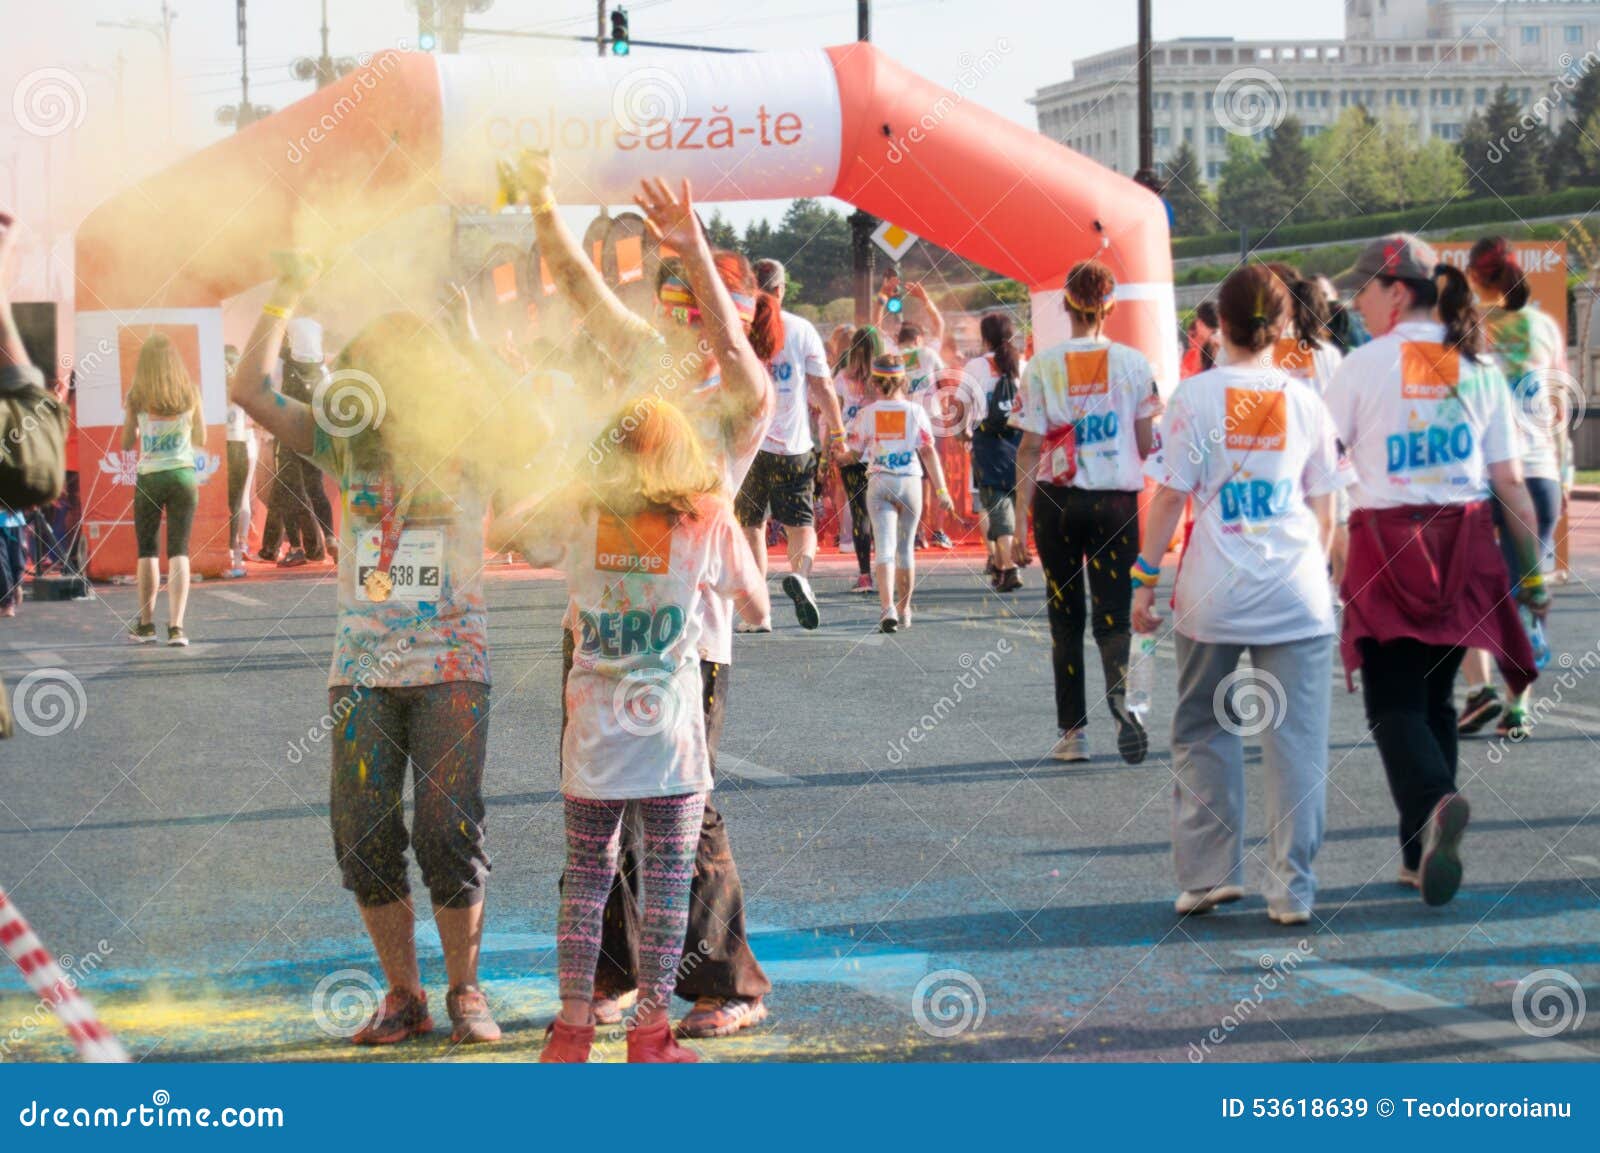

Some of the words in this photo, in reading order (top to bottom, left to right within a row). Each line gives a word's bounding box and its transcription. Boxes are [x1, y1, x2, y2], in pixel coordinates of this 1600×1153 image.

[483, 104, 803, 150] colorează-te
[1072, 410, 1118, 446] ERO
[1386, 422, 1473, 473] DERO
[1220, 478, 1293, 523] DERO
[598, 552, 663, 572] orange
[577, 604, 687, 659] DERO
